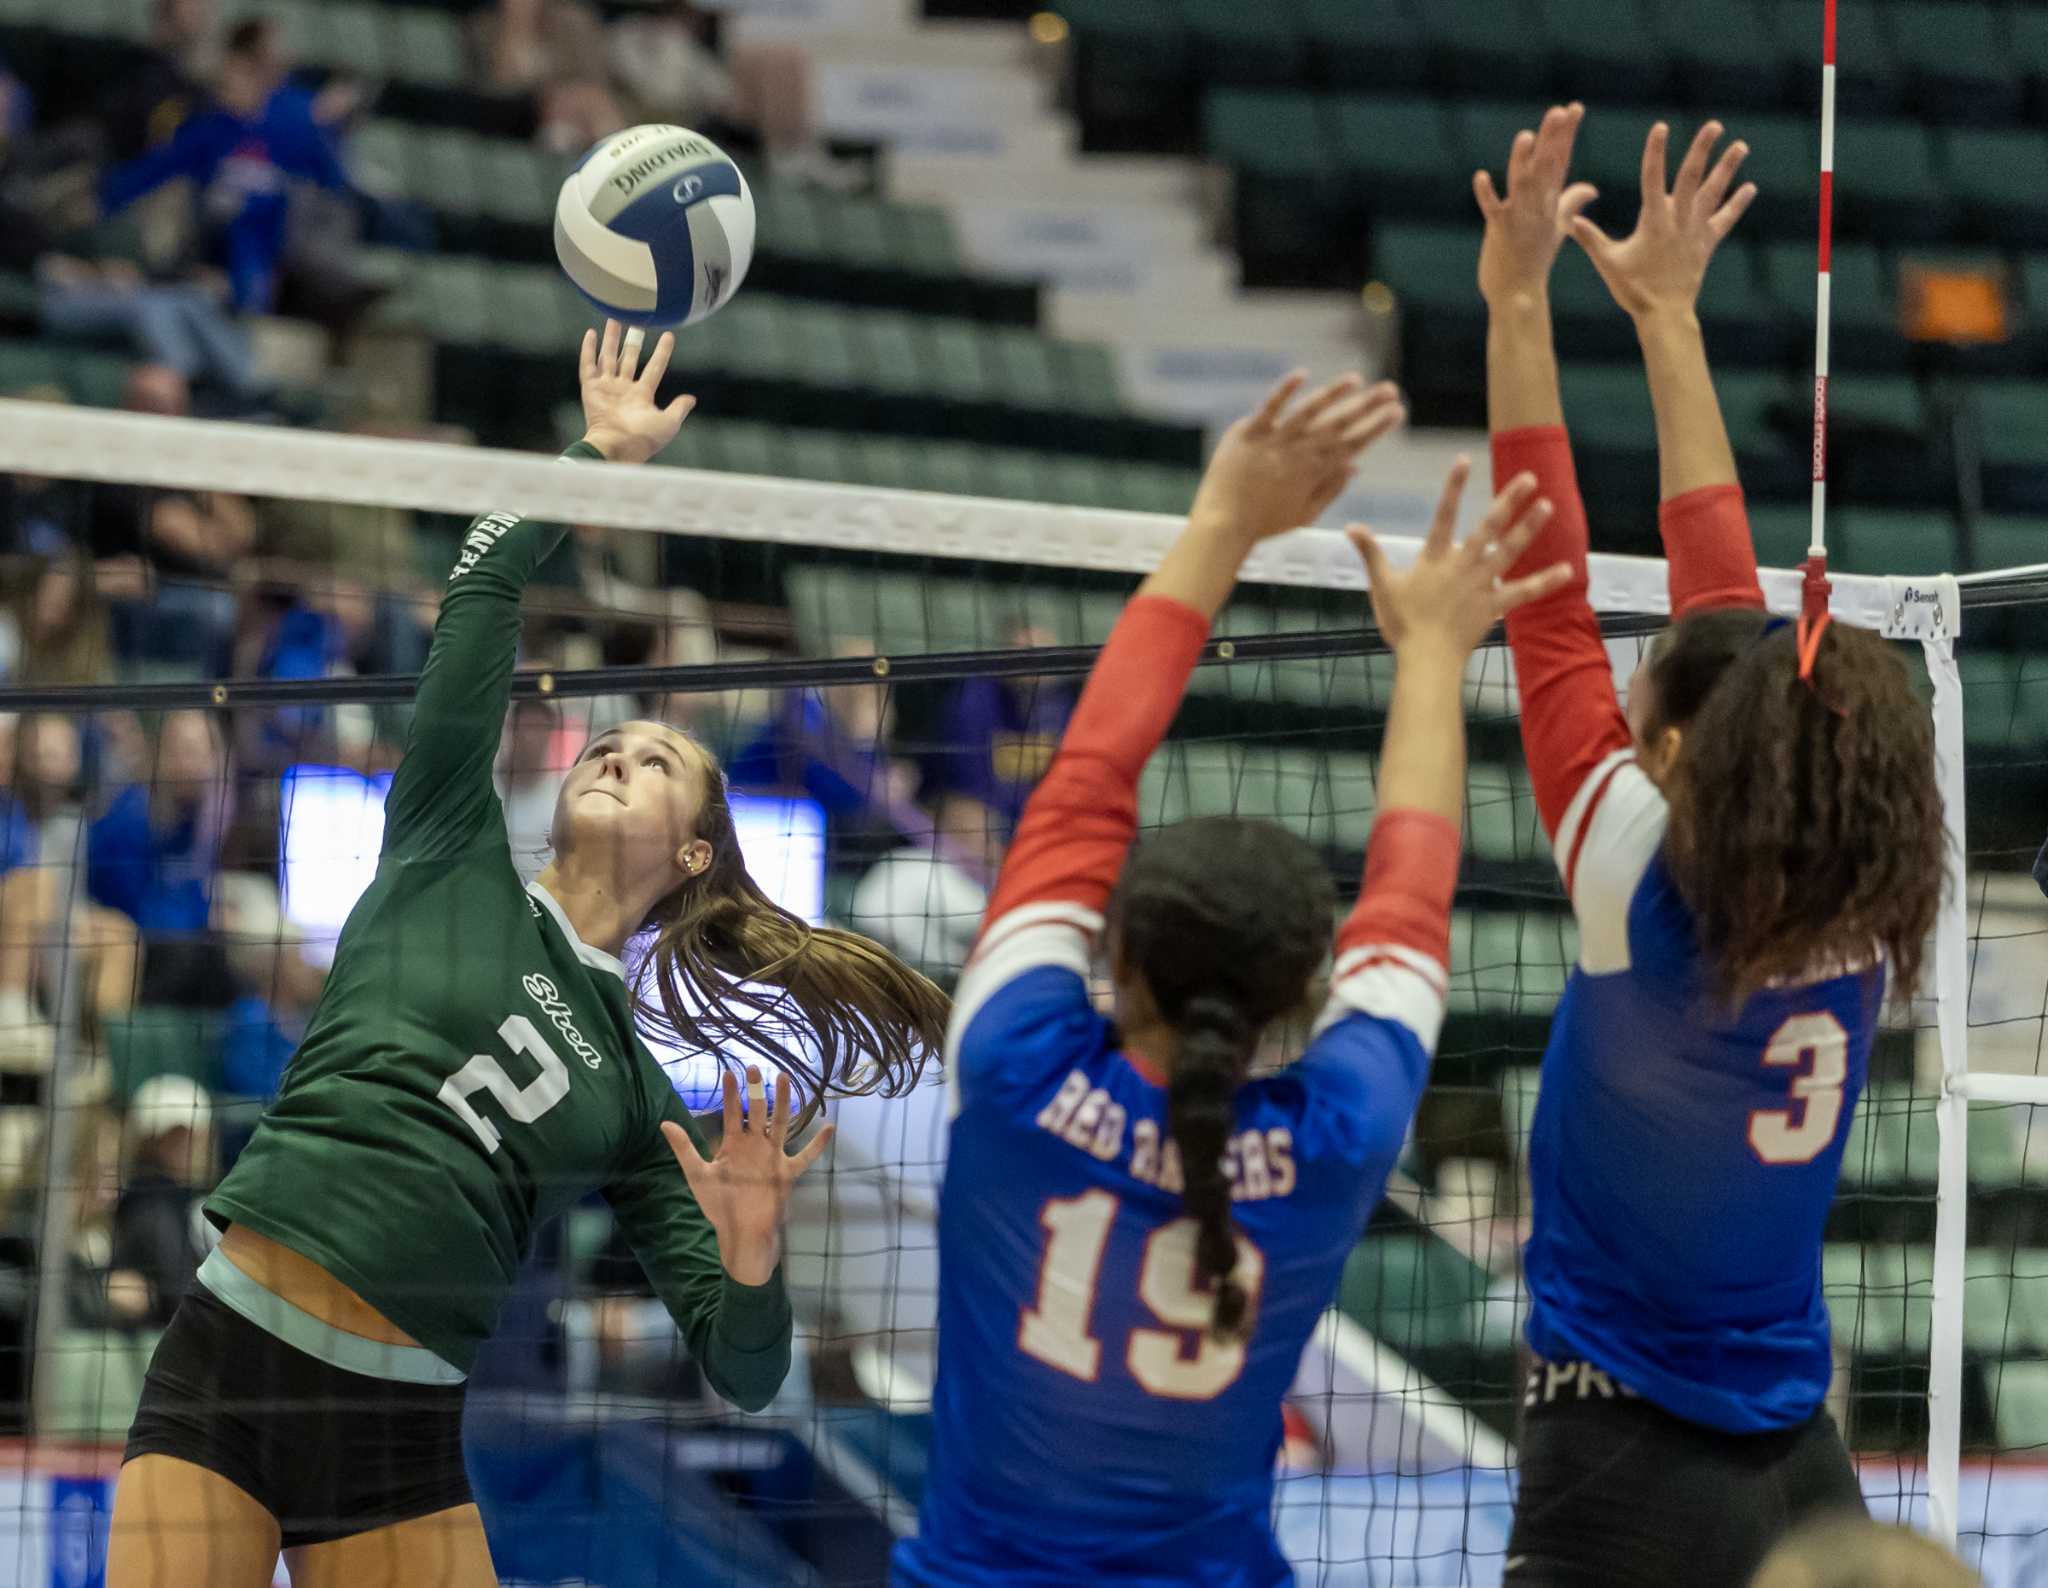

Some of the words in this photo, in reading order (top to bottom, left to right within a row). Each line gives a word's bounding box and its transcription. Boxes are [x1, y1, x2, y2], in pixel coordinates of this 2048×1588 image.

[436, 1014, 571, 1155] 2
[522, 973, 602, 1070] Shen
[1745, 1010, 1849, 1165] 3
[1035, 1068, 1127, 1162] RED
[1017, 1187, 1266, 1404] 19
